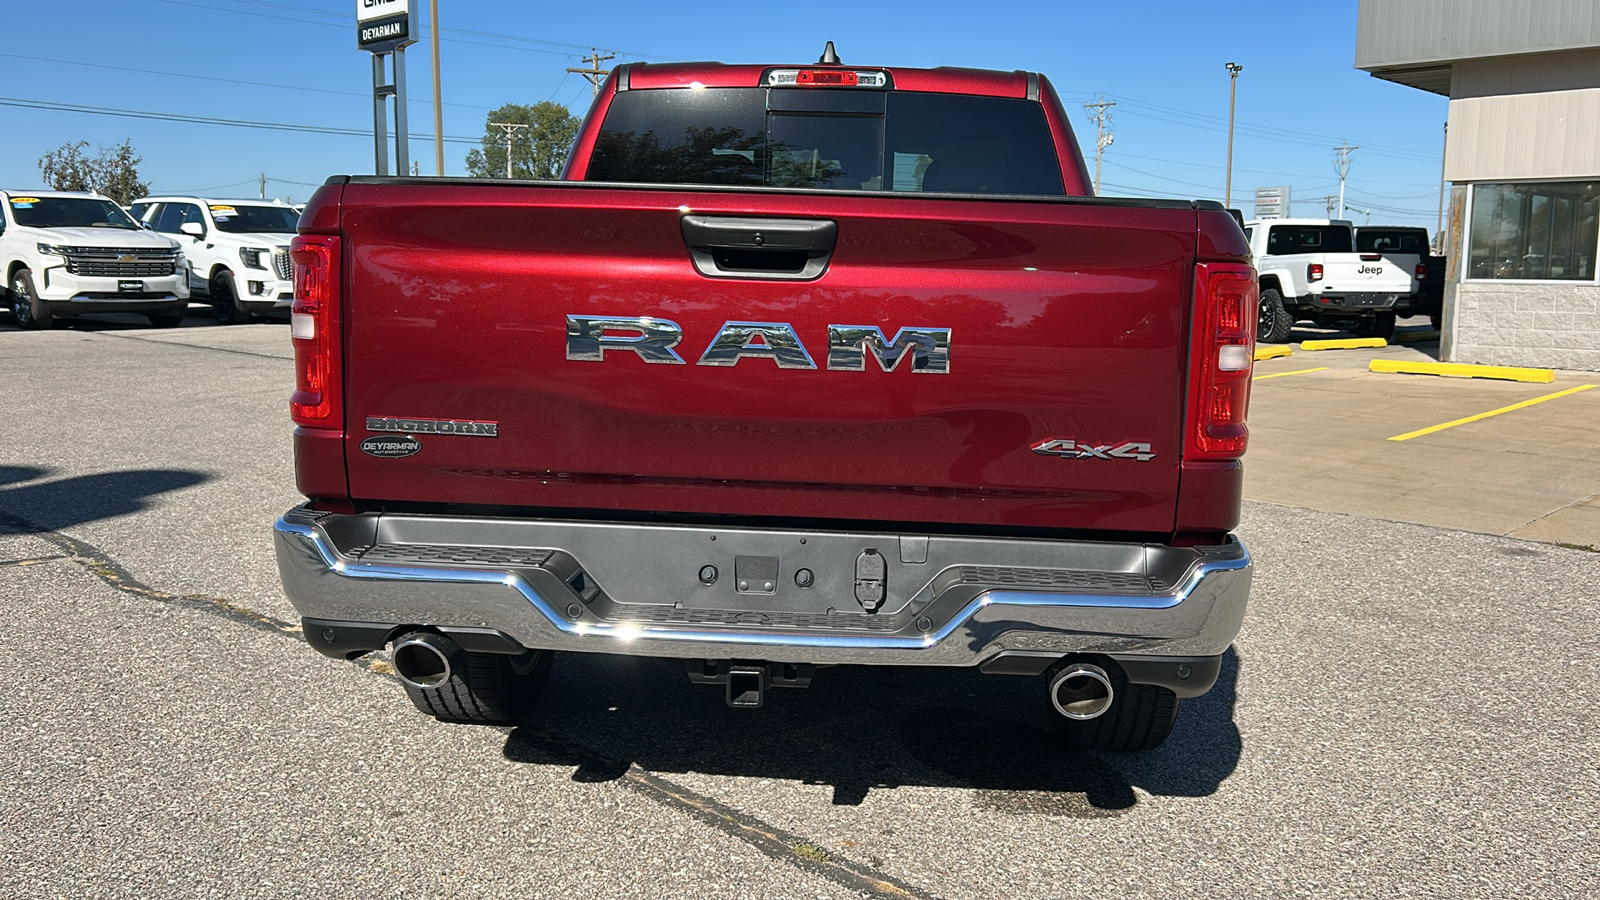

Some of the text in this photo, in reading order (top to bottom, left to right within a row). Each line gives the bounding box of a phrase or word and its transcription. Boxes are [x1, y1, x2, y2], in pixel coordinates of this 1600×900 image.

[362, 22, 400, 41] DEYARMAN
[1357, 264, 1383, 276] Jeep
[566, 314, 952, 374] RAM
[366, 416, 498, 437] BIGHORN
[363, 442, 419, 450] DEYARMAN
